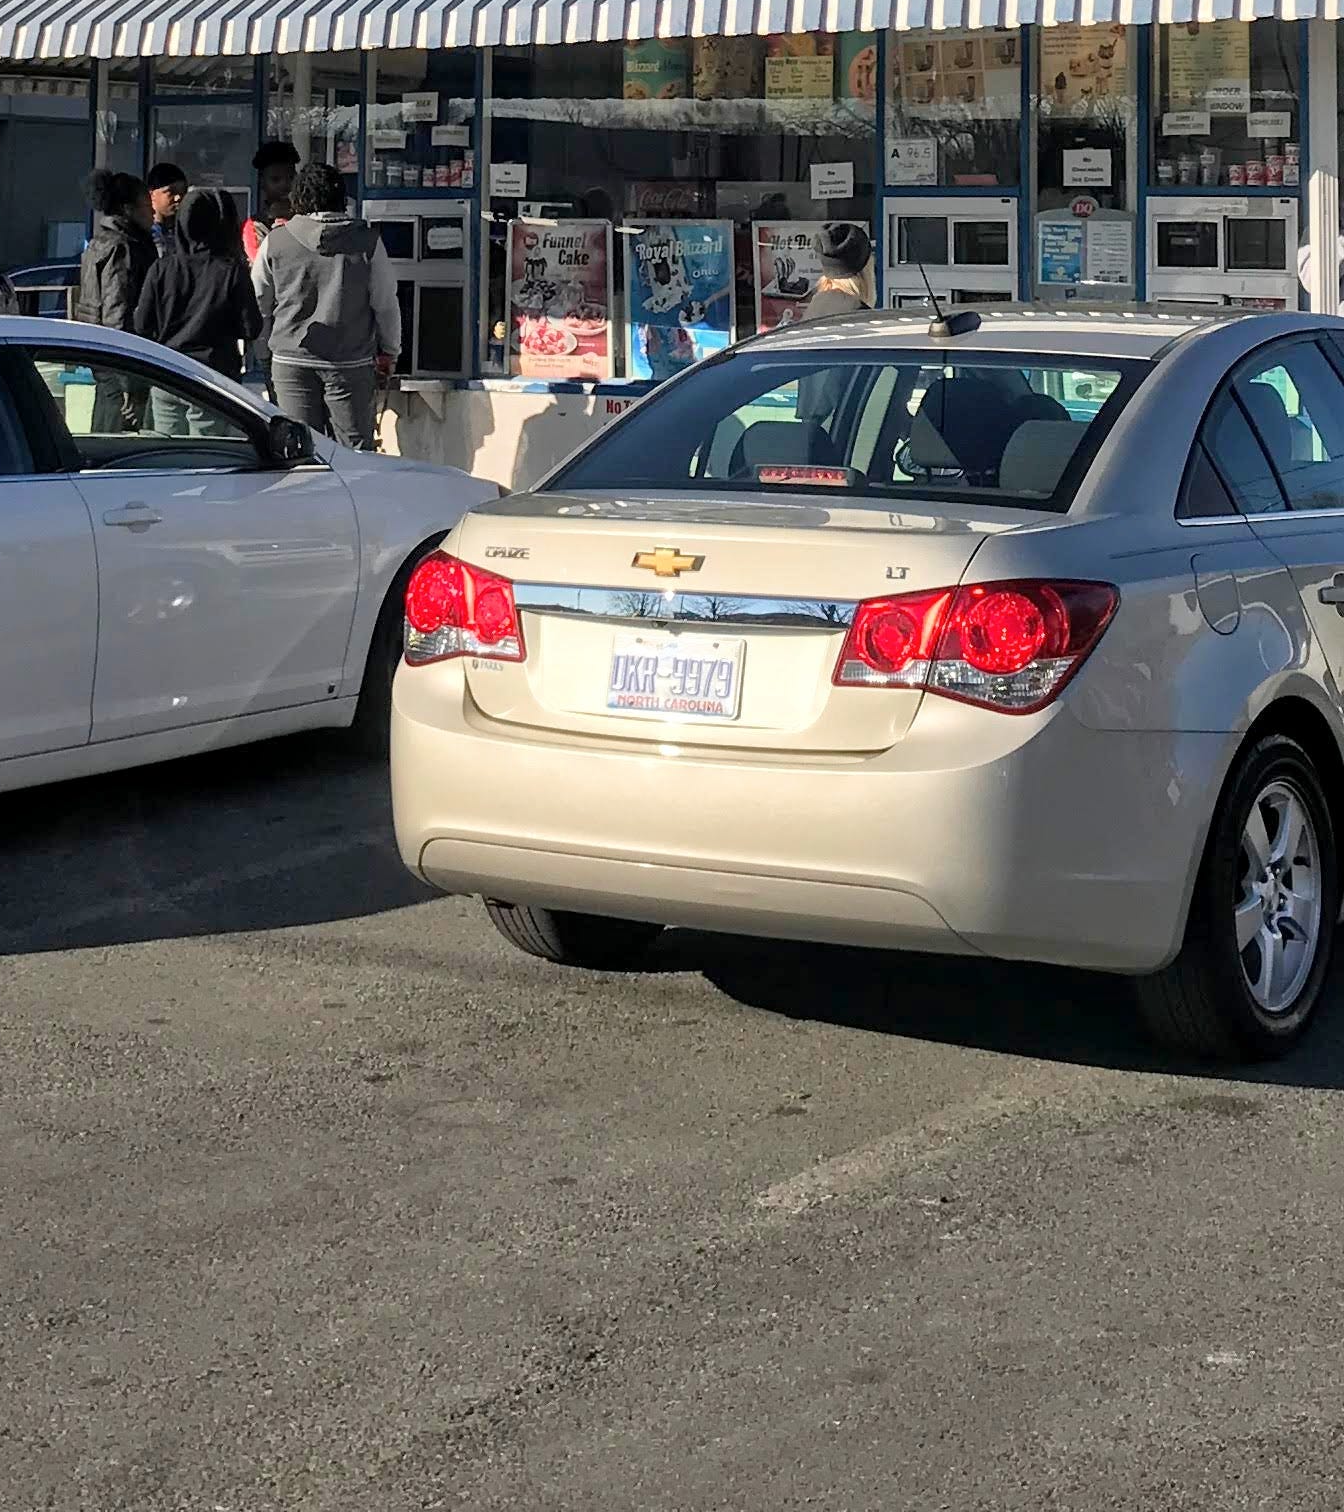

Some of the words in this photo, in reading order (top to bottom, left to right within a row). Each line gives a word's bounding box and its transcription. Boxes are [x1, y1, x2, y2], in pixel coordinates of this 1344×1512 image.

[891, 148, 900, 158] A
[1075, 203, 1093, 215] DQ
[542, 232, 586, 249] Funnel
[558, 249, 590, 266] Cake
[635, 240, 674, 264] Royal
[886, 566, 911, 580] LT
[617, 694, 660, 710] NORTH
[664, 698, 724, 713] CAROLINA
